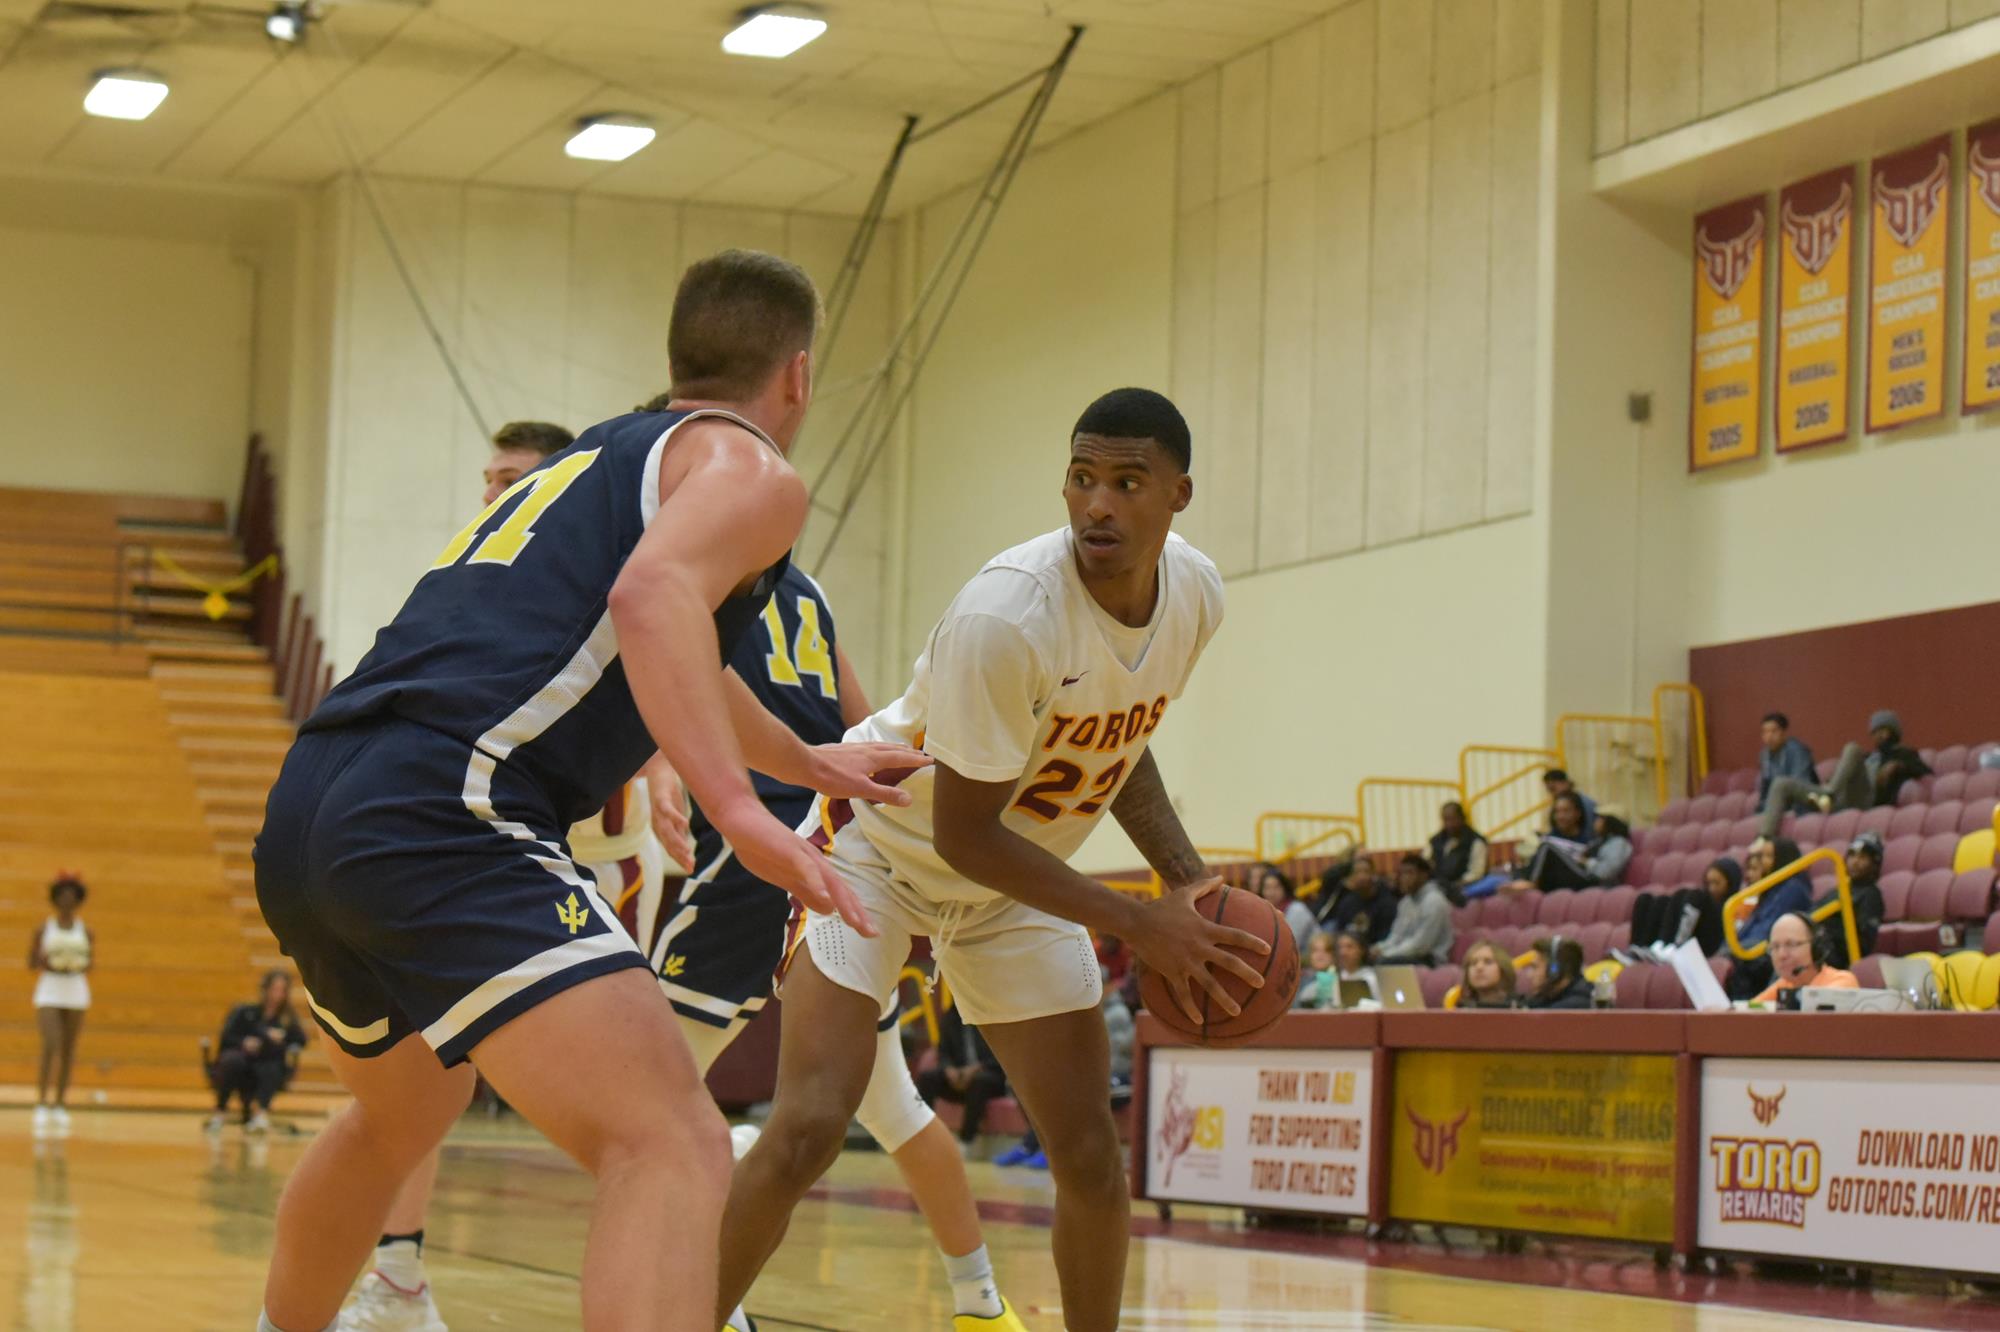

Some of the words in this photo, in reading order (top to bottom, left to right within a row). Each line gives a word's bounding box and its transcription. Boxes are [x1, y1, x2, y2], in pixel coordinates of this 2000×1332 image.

[1874, 269, 1944, 303] CONFERENCE
[1781, 297, 1846, 328] CONFERENCE
[1880, 294, 1937, 325] CHAMPION
[1788, 320, 1841, 349] CHAMPION
[1893, 329, 1923, 350] MEN'S
[1704, 345, 1753, 372] CHAMPION
[1889, 349, 1926, 371] SOCCER
[759, 591, 838, 700] 14
[1042, 693, 1169, 752] TOROS
[1009, 756, 1130, 824] 22
[1258, 1069, 1299, 1102] THANK
[1304, 1070, 1331, 1103] YOU
[1249, 1114, 1274, 1146] FOR
[1277, 1115, 1361, 1150] SUPPORTING
[1481, 1096, 1606, 1138] DOMINGUEZ
[1614, 1101, 1672, 1142] HILLS
[1479, 1151, 1547, 1174] University
[1551, 1155, 1607, 1178] Housing
[1612, 1158, 1672, 1179] Services
[1710, 1136, 1821, 1198] TORO
[1858, 1130, 1965, 1171] DOWNLOAD
[1968, 1133, 2000, 1173] NO
[1251, 1159, 1284, 1192] TORO
[1287, 1161, 1357, 1196] ATHLETICS
[1721, 1190, 1805, 1227] REWARDS
